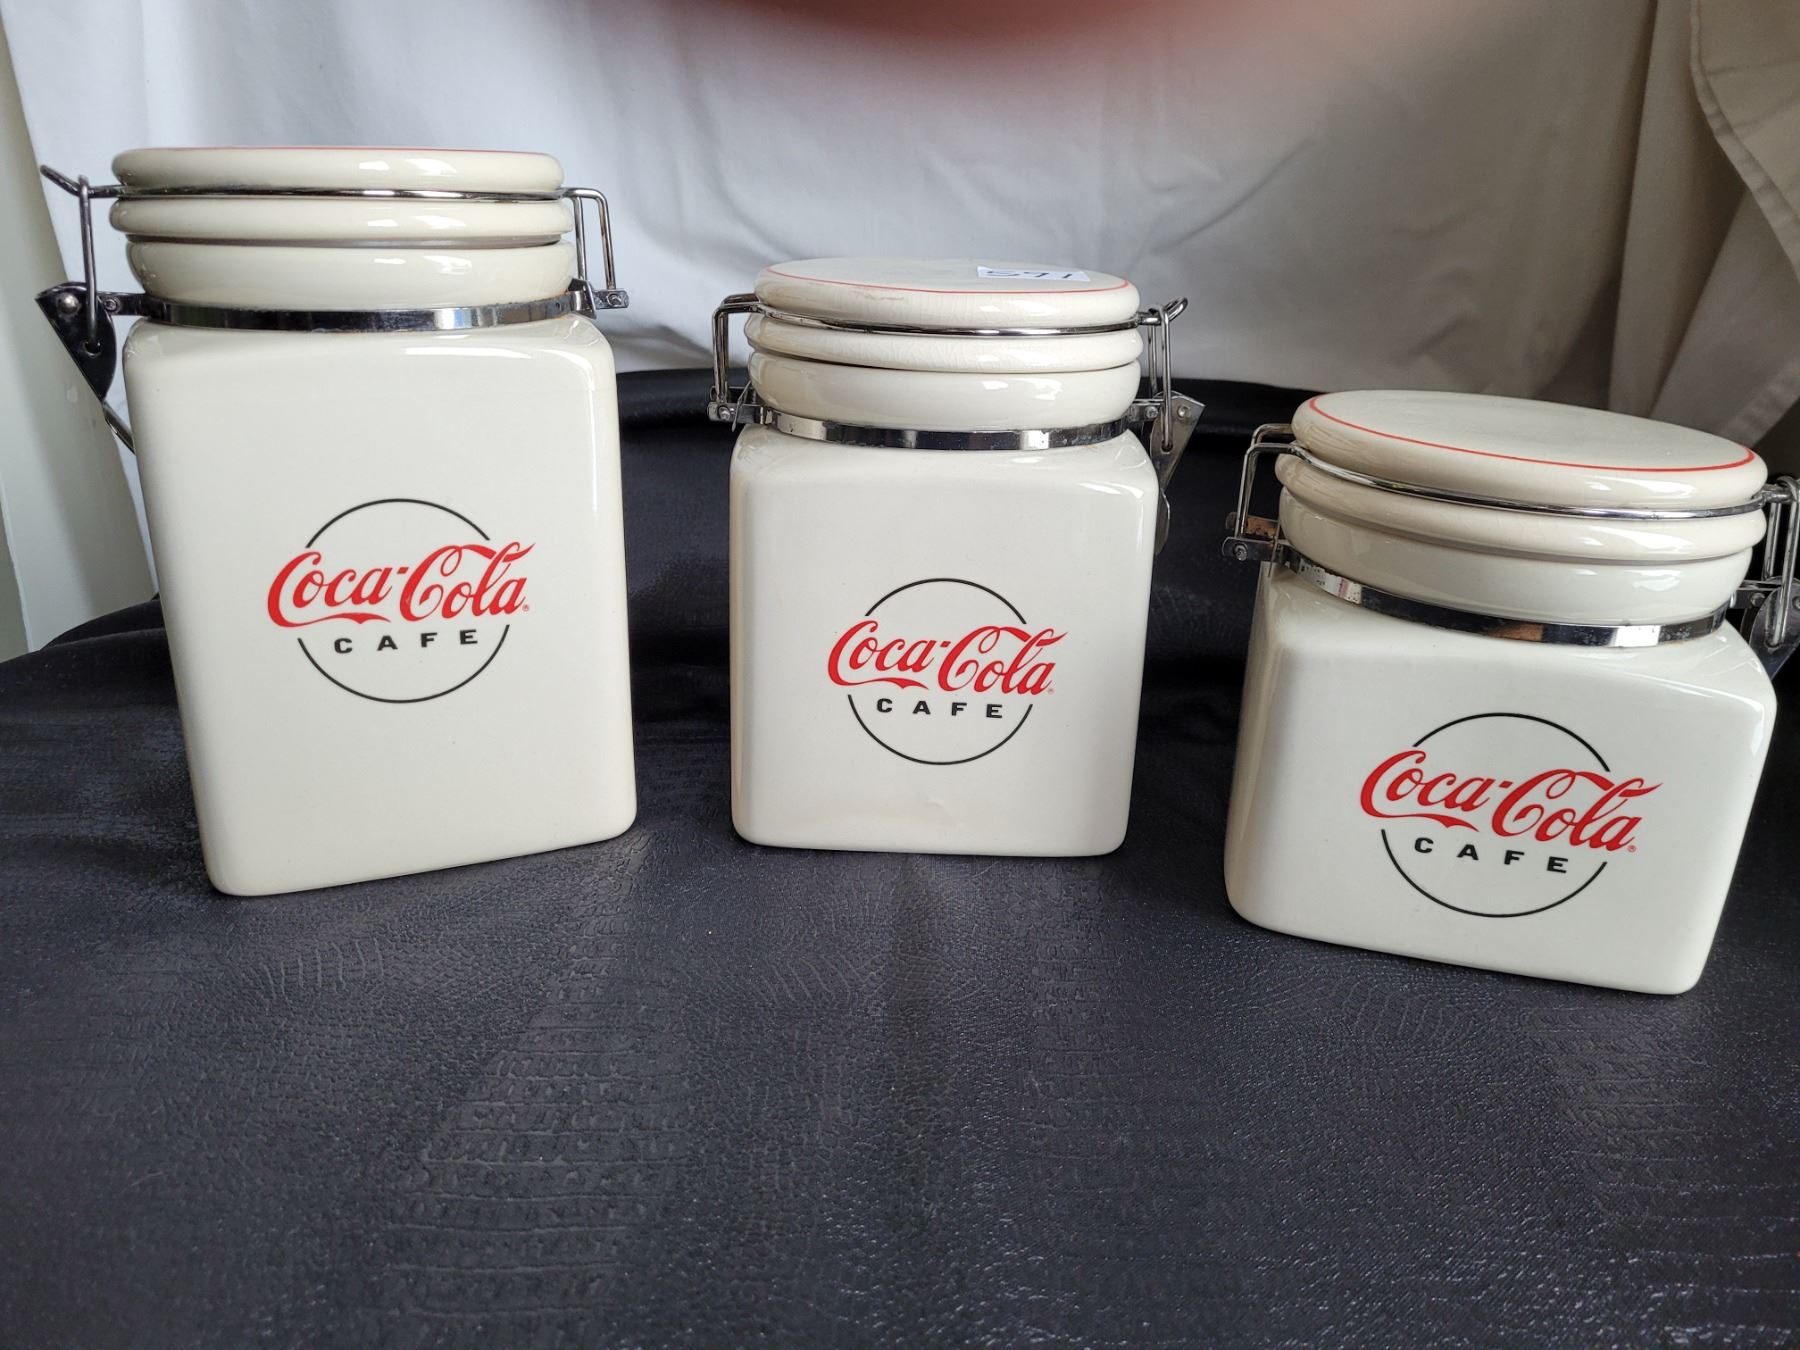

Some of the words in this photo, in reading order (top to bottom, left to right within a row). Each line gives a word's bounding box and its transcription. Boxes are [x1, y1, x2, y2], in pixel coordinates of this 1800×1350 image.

[267, 541, 536, 628] Coca-Cola
[333, 629, 479, 654] CAFE
[827, 619, 1068, 696] Coca-Cola
[876, 698, 1004, 719] CAFE
[1359, 749, 1663, 852] Coca-Cola
[1413, 837, 1569, 874] CAFE
